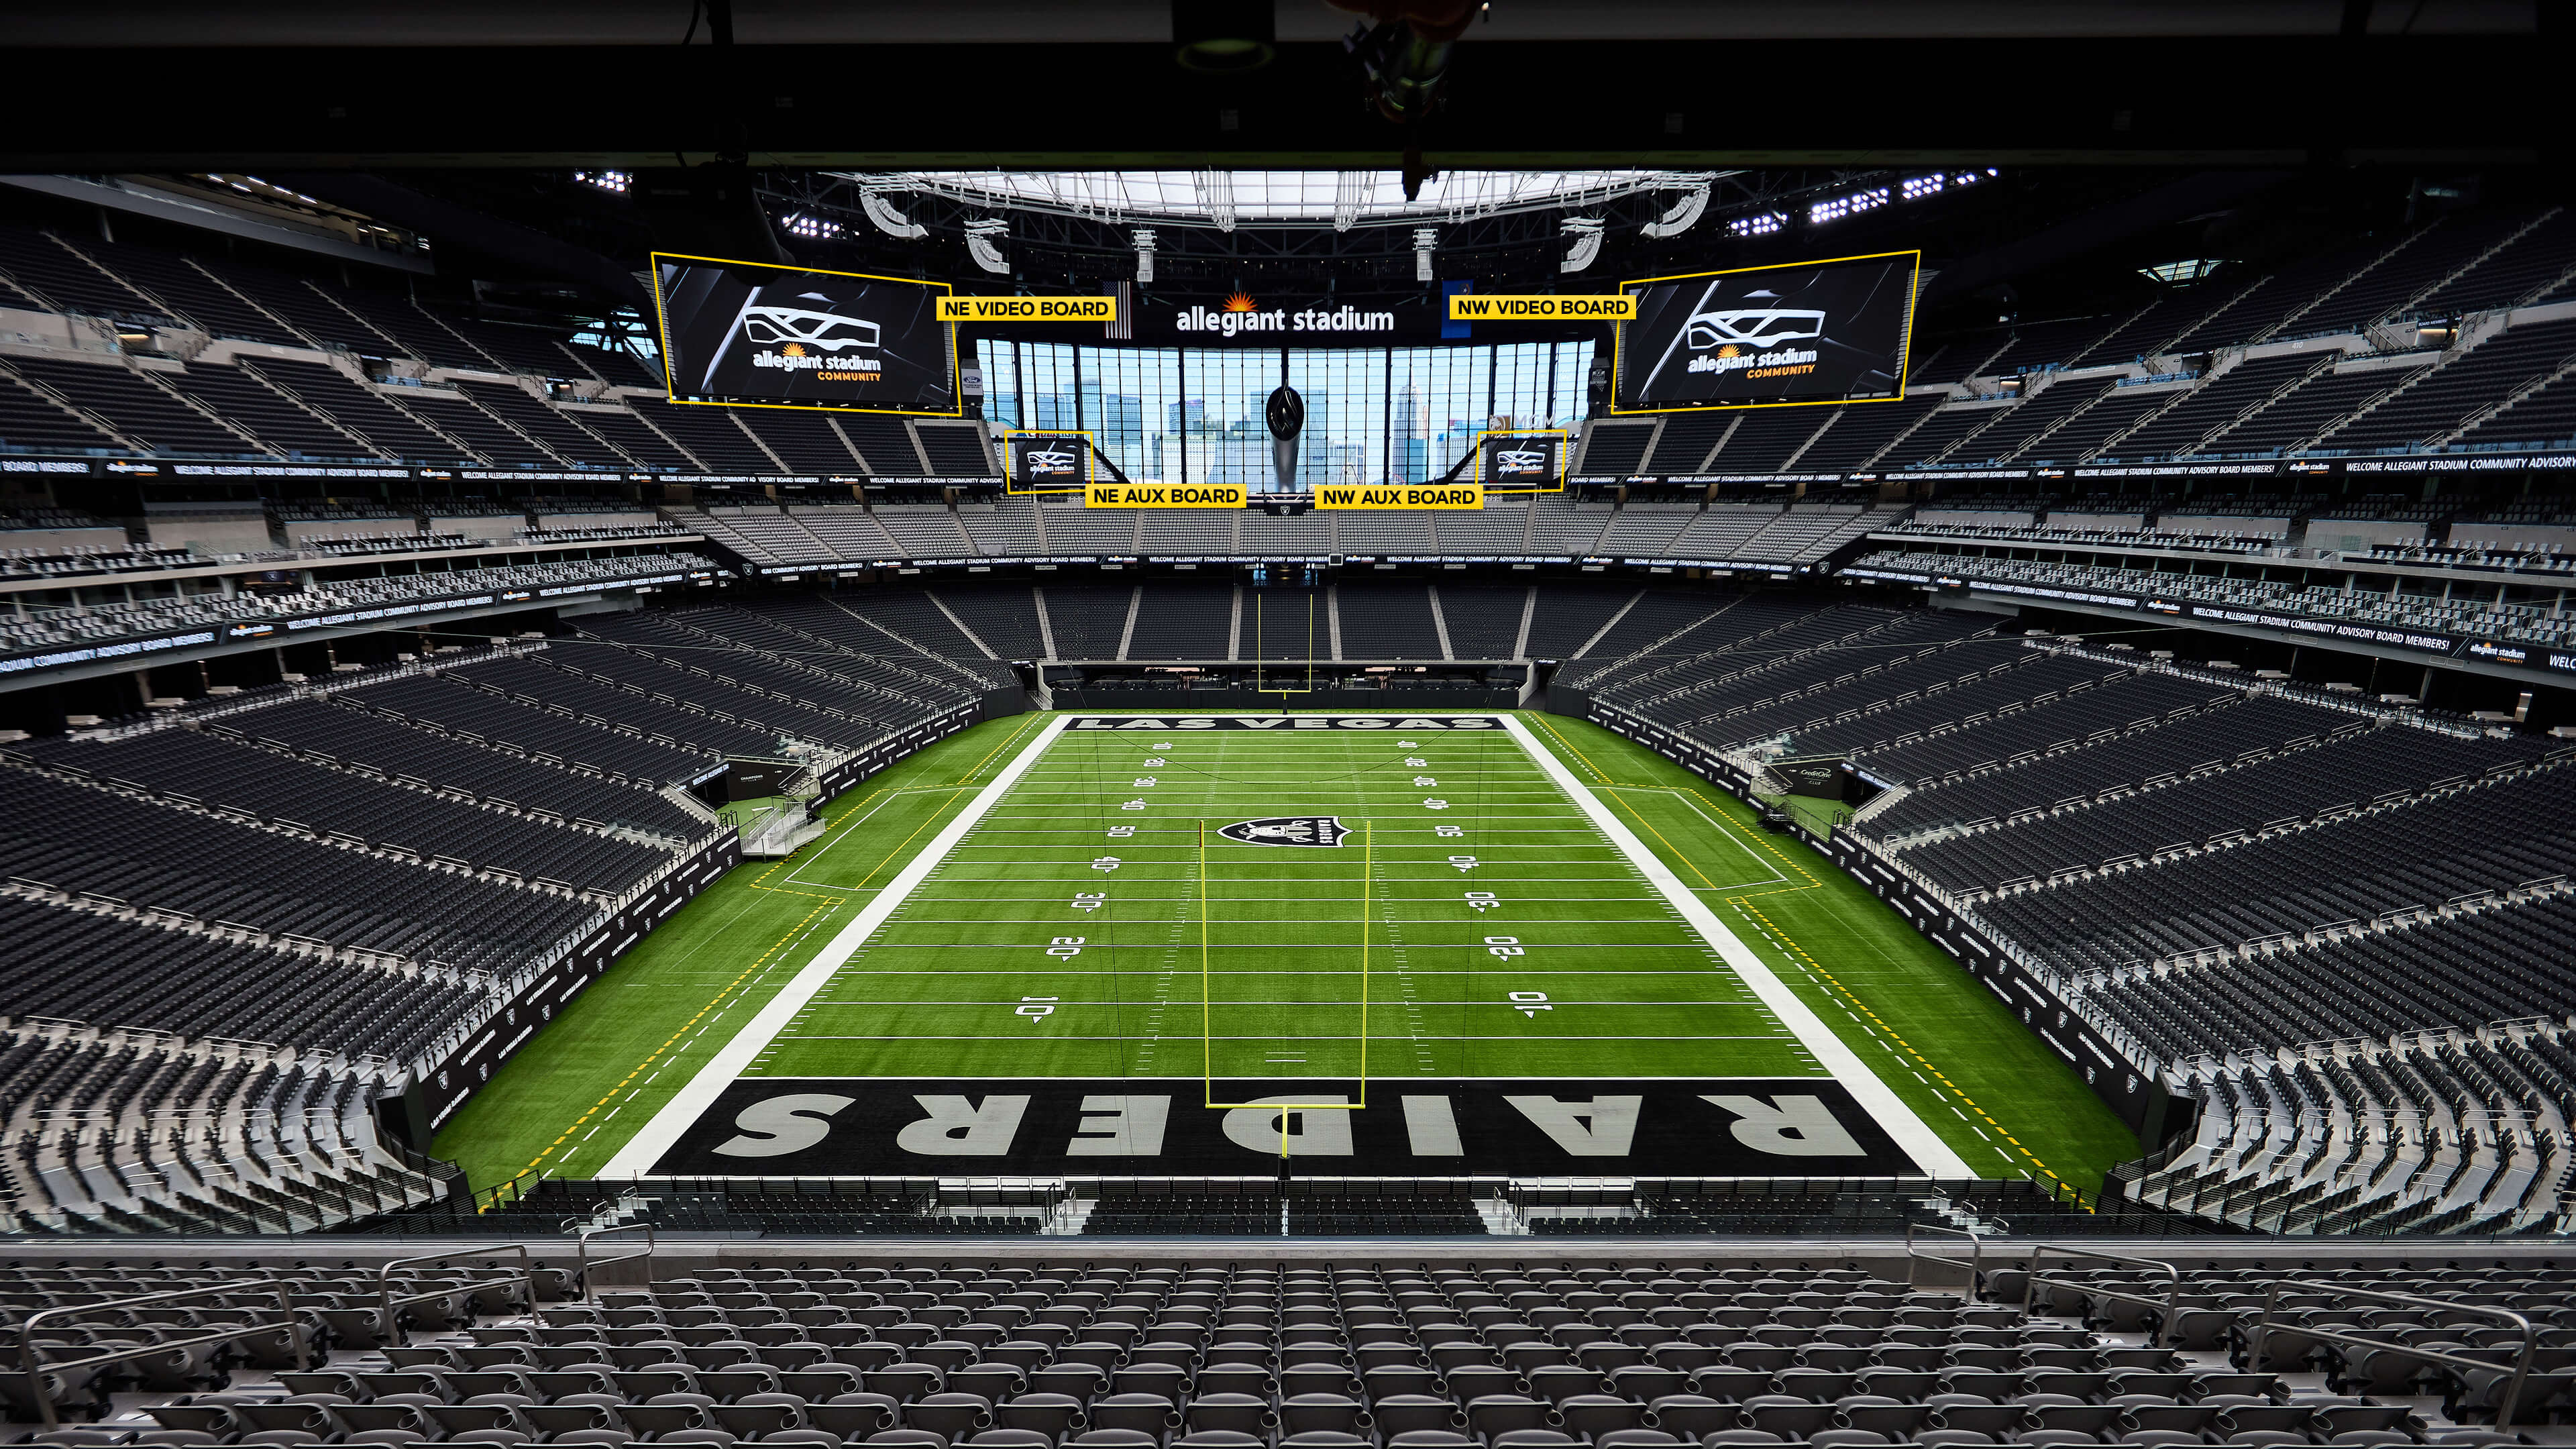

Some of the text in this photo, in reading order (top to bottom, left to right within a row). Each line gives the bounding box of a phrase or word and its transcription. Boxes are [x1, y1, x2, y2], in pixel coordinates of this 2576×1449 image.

[1177, 305, 1395, 336] allegiant stadium
[753, 350, 881, 372] allegiant stadium
[1687, 348, 1817, 375] allegiant stadium
[817, 372, 881, 382] COMMUNITY
[1747, 364, 1815, 380] COMMUNITY
[2347, 462, 2382, 471] WELCOME
[2384, 462, 2428, 470] ALLEGIANT
[2428, 460, 2469, 470] STADIUM
[2470, 458, 2528, 469] COMMUNITY
[2193, 608, 2450, 649] WELCOME ALLEGIANT STADIUM COMMUNITY ADVISORY BOARD MEMBERS!
[2498, 647, 2526, 658] stadium
[1076, 718, 1493, 729] LAS VEGAS
[1107, 825, 1136, 838] 50
[1318, 820, 1334, 843] RAIDERS
[1434, 825, 1464, 838] 50
[1090, 856, 1122, 869] 40
[1448, 855, 1480, 869] 40
[1069, 891, 1106, 910] 30
[1464, 891, 1501, 910] 30
[1044, 936, 1087, 957] 20
[1483, 936, 1525, 957] 20
[1014, 996, 1060, 1016] 10
[1507, 991, 1554, 1012] 10
[711, 1093, 1868, 1158] RAIDERS
